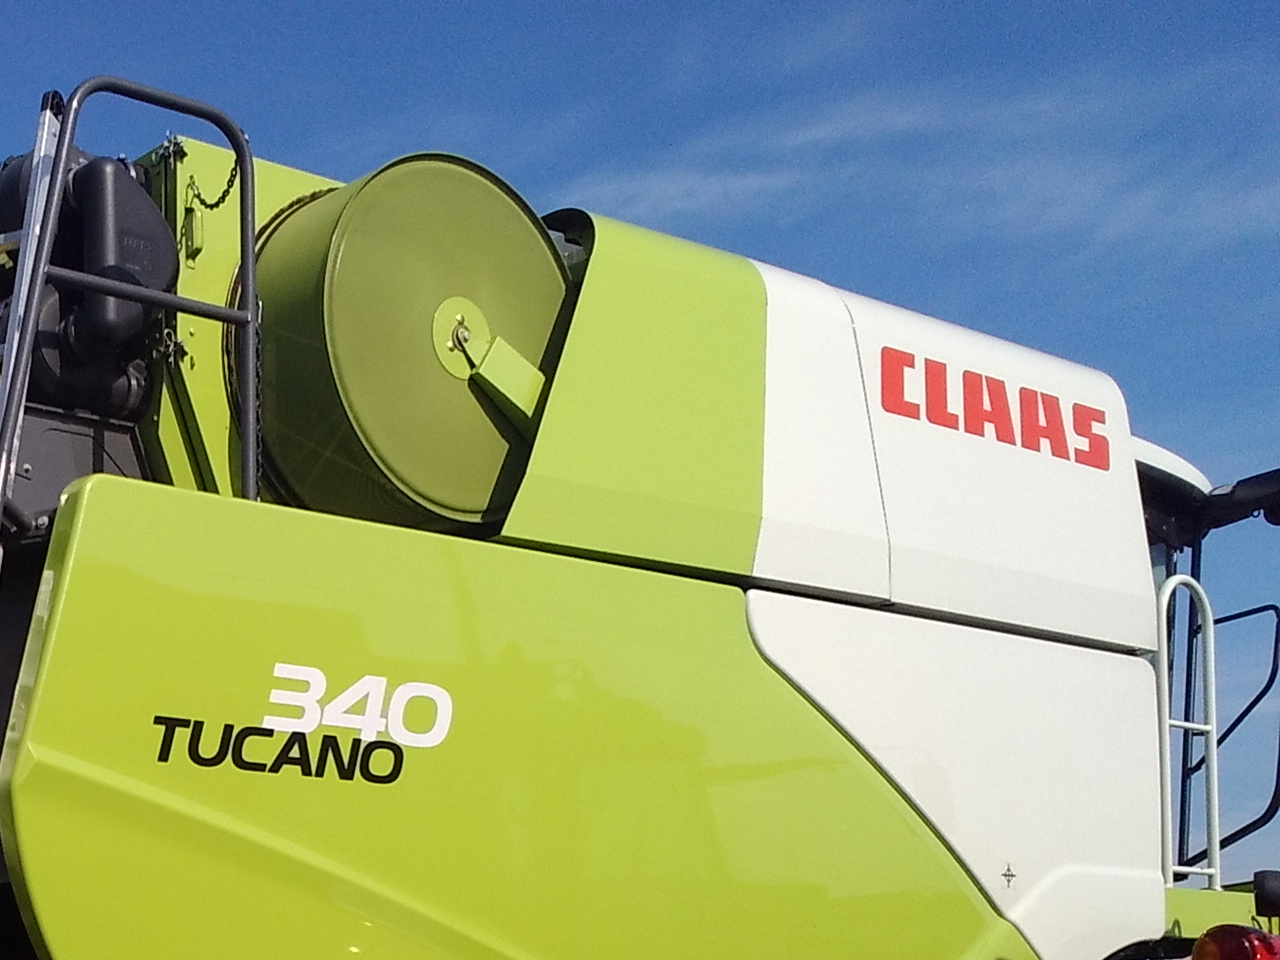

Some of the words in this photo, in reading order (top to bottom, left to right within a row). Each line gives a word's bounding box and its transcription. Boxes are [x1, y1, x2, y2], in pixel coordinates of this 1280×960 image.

[880, 346, 1110, 471] CLAAS
[262, 662, 453, 748] 340
[152, 715, 404, 784] TUCANO
